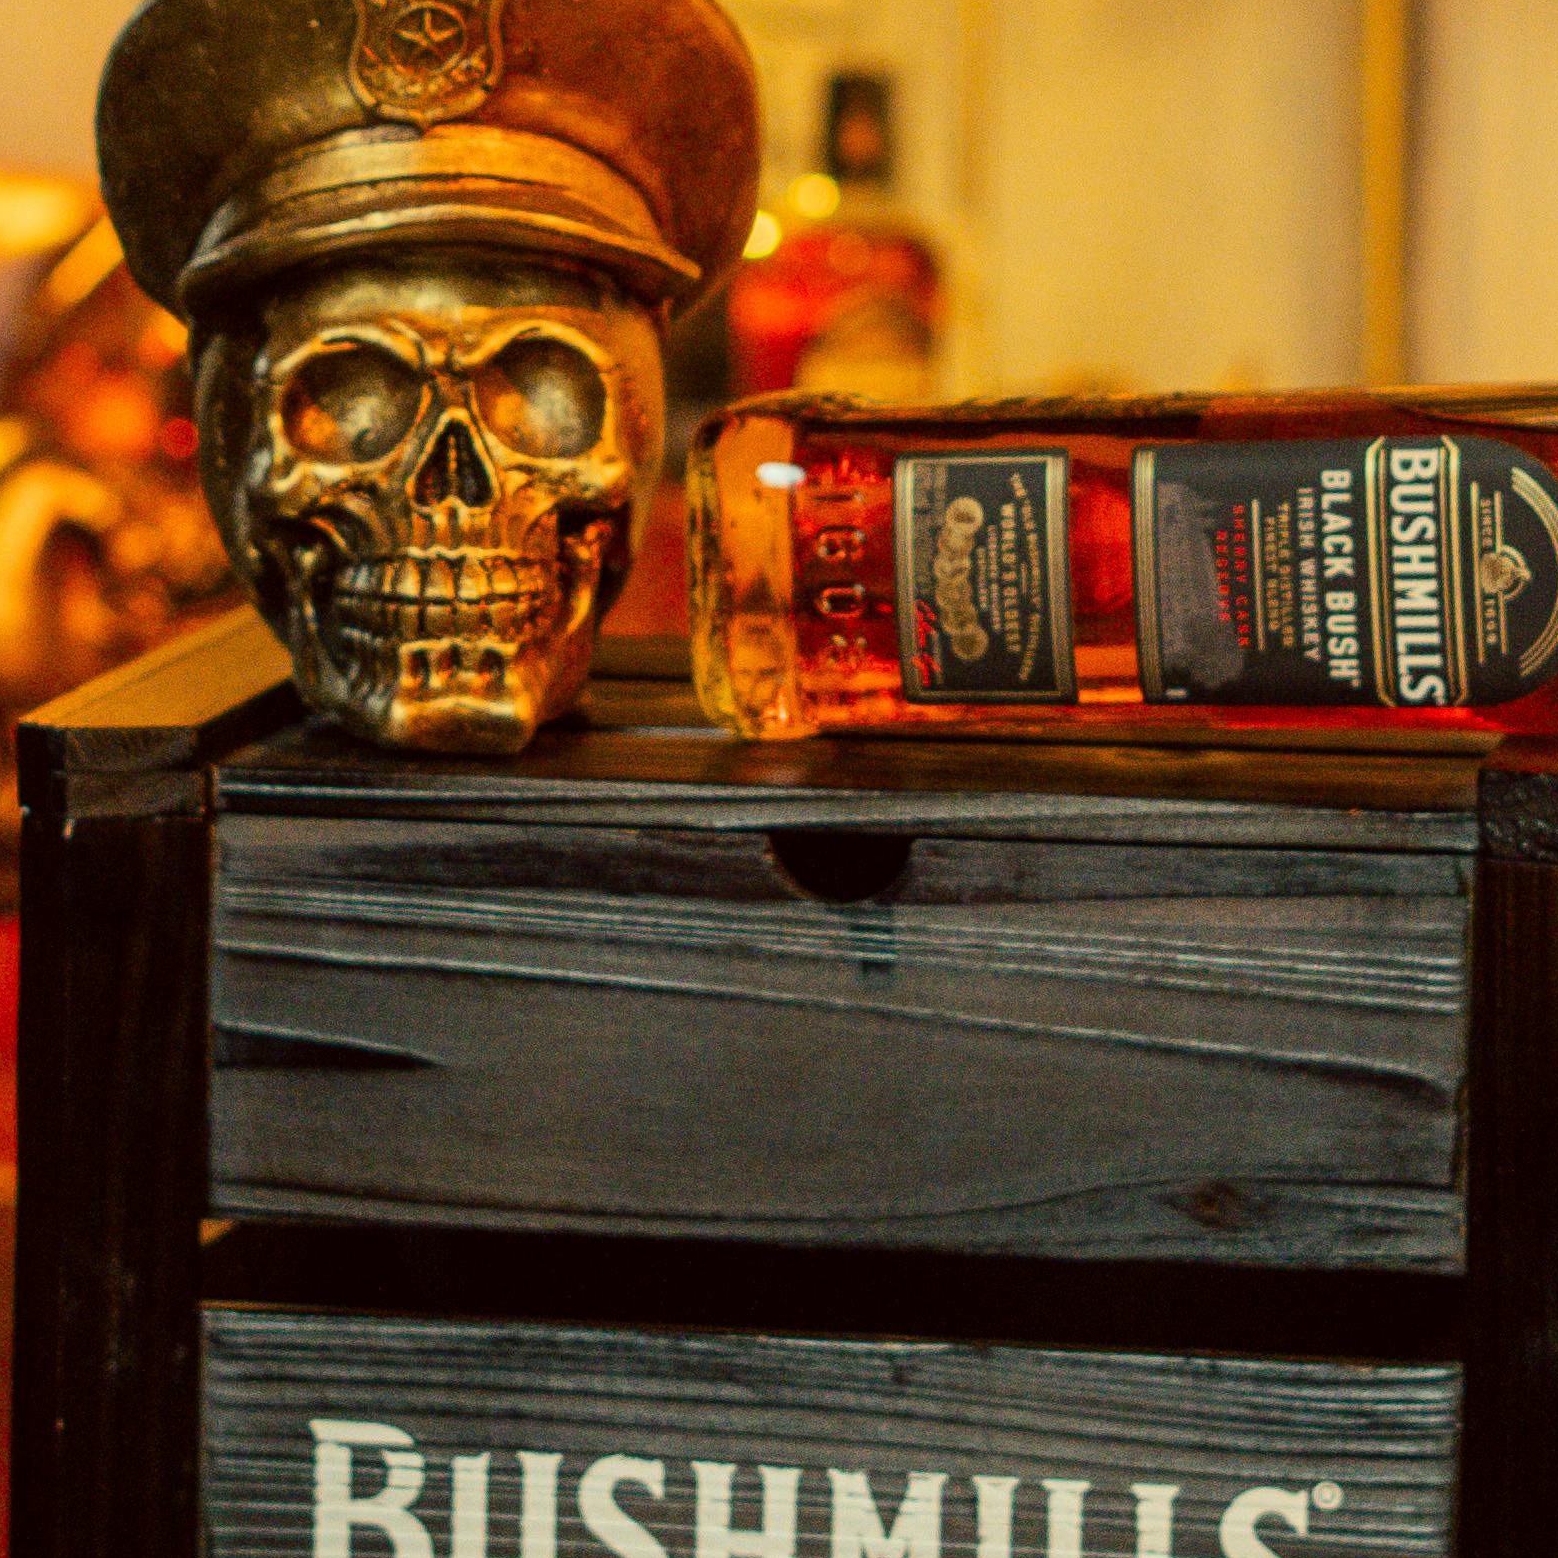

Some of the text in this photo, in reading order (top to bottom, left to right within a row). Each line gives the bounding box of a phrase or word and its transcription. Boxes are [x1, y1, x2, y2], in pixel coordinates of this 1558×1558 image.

[1215, 530, 1231, 623] RESERVE
[1232, 504, 1250, 647] SHERRY CASK
[1298, 488, 1322, 662] IRISH WHISKEY
[1321, 470, 1361, 690] BLACK BUSH
[1389, 447, 1446, 706] BUSHMILLS
